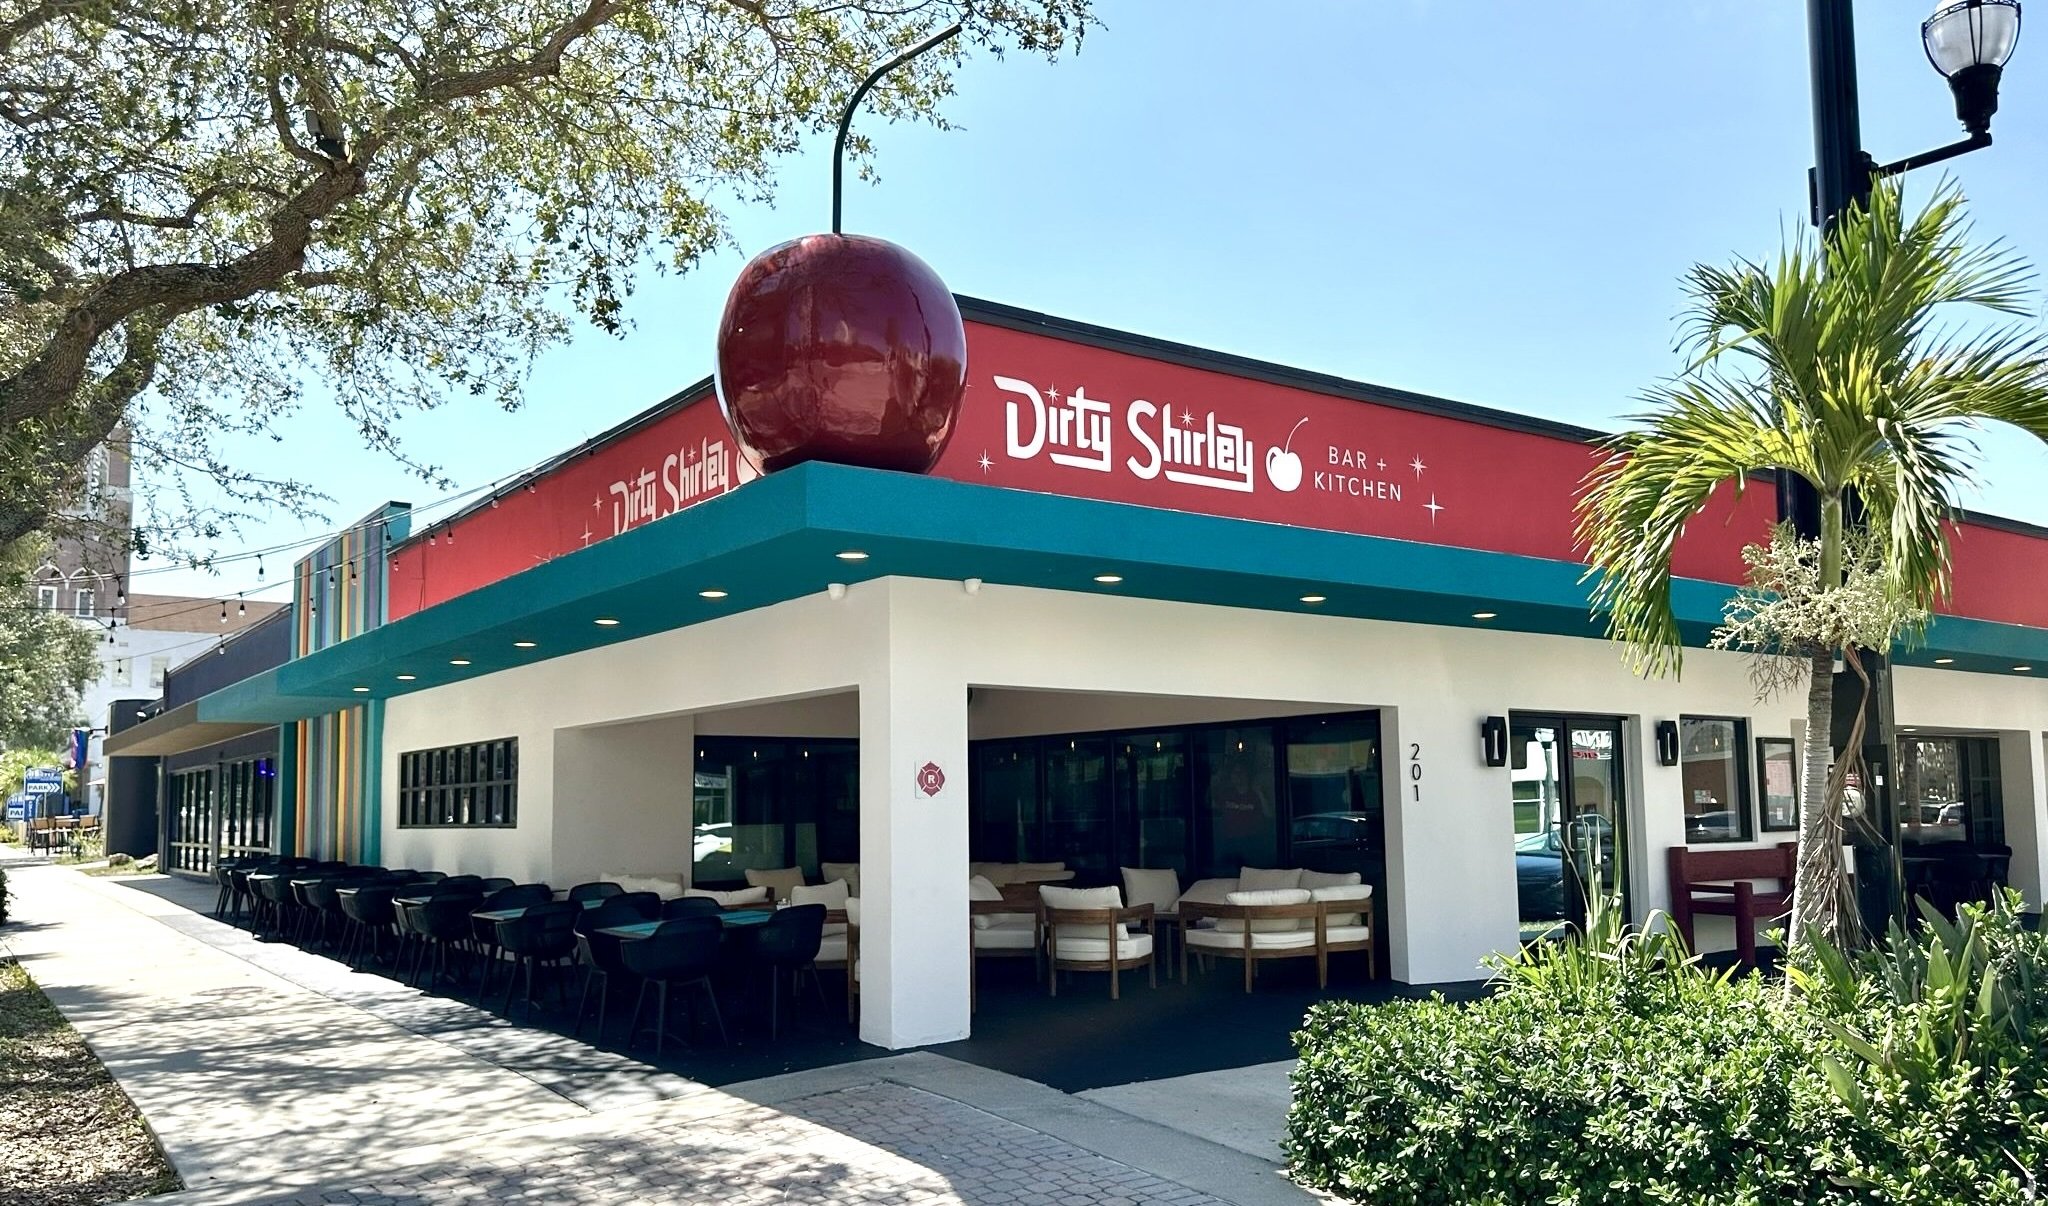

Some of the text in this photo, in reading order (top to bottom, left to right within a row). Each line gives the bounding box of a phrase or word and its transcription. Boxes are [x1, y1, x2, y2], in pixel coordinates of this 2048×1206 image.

[993, 375, 1255, 493] Dirty Shirley
[1328, 445, 1368, 470] BAR
[609, 436, 729, 536] Dirty Shirley
[1314, 470, 1401, 502] KITCHEN
[927, 774, 936, 784] R
[1410, 743, 1422, 802] 201
